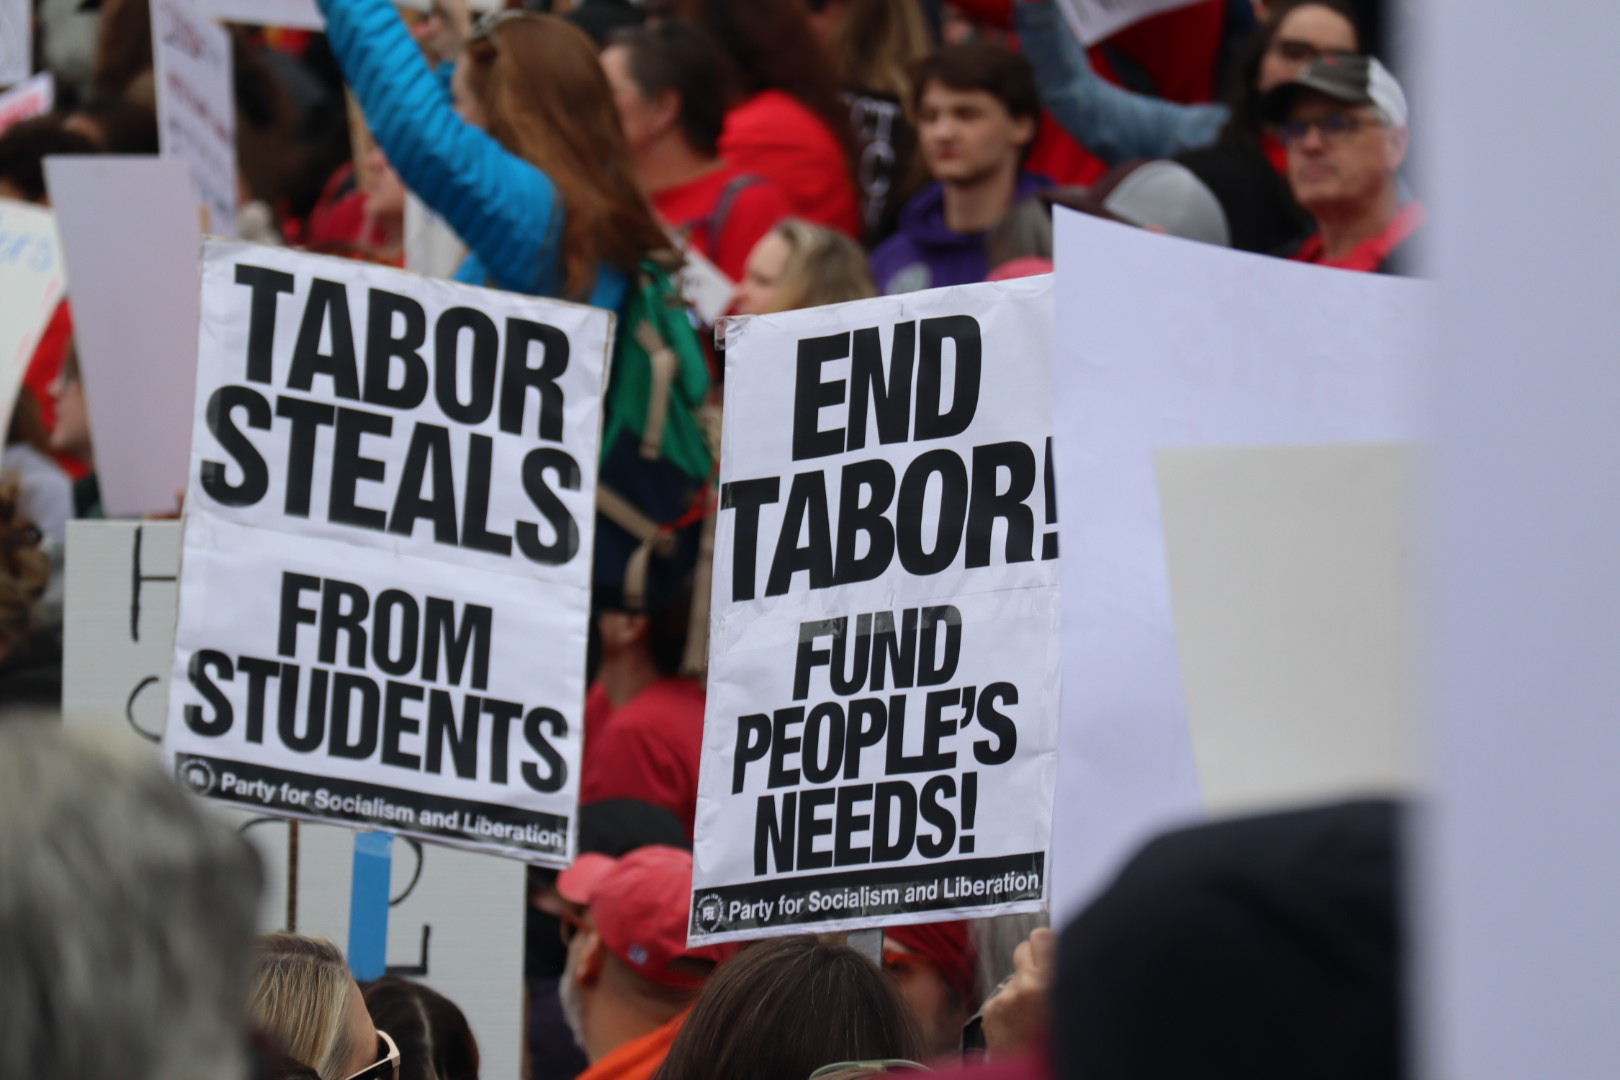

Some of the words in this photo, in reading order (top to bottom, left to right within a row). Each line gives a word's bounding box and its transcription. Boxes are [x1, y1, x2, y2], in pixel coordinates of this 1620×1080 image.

[234, 263, 570, 443] TABOR
[792, 314, 982, 462] END
[200, 384, 582, 567] STEALS
[720, 436, 1059, 603] TABOR!
[277, 571, 493, 691] FROM
[792, 604, 962, 701] FUND
[183, 649, 568, 794] STUDENTS
[732, 681, 1019, 795] PEOPLE'S
[221, 772, 276, 803] Party
[280, 781, 310, 806] for
[314, 788, 414, 824] Socialism
[419, 809, 459, 831] and
[463, 812, 563, 848] Liberation
[754, 771, 978, 877] NEEDS!
[728, 899, 774, 922] Party
[778, 895, 804, 915] for
[808, 886, 899, 912] Socialism
[904, 879, 938, 903] and
[943, 870, 1039, 899] Liberation
